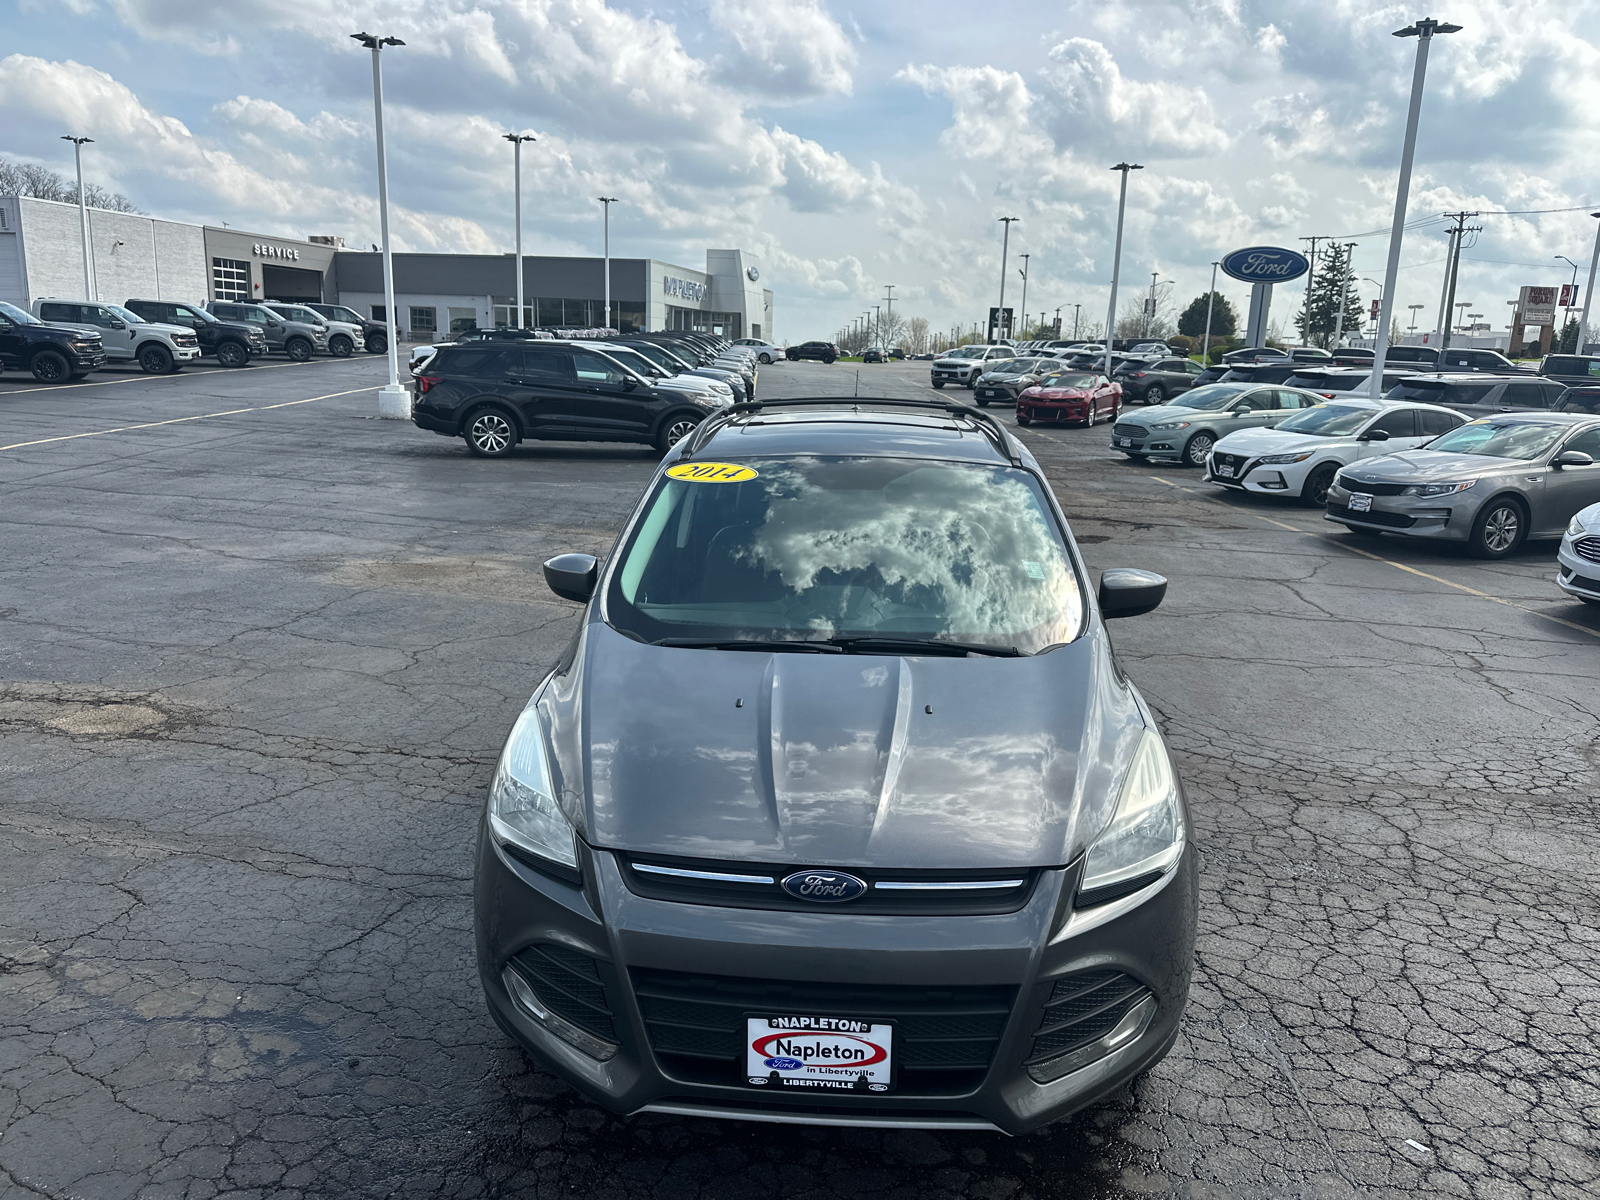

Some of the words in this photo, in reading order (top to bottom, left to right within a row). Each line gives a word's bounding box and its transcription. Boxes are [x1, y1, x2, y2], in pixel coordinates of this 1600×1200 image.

[253, 243, 300, 260] SERVICE
[1241, 252, 1293, 276] Ford
[676, 465, 746, 479] 2014
[799, 874, 848, 897] Ford
[777, 1017, 863, 1032] NAPLETON
[775, 1038, 866, 1061] Napleton
[771, 1058, 797, 1069] Ford
[818, 1066, 876, 1077] Libertyville
[783, 1078, 854, 1089] LIBERTYVILLE
